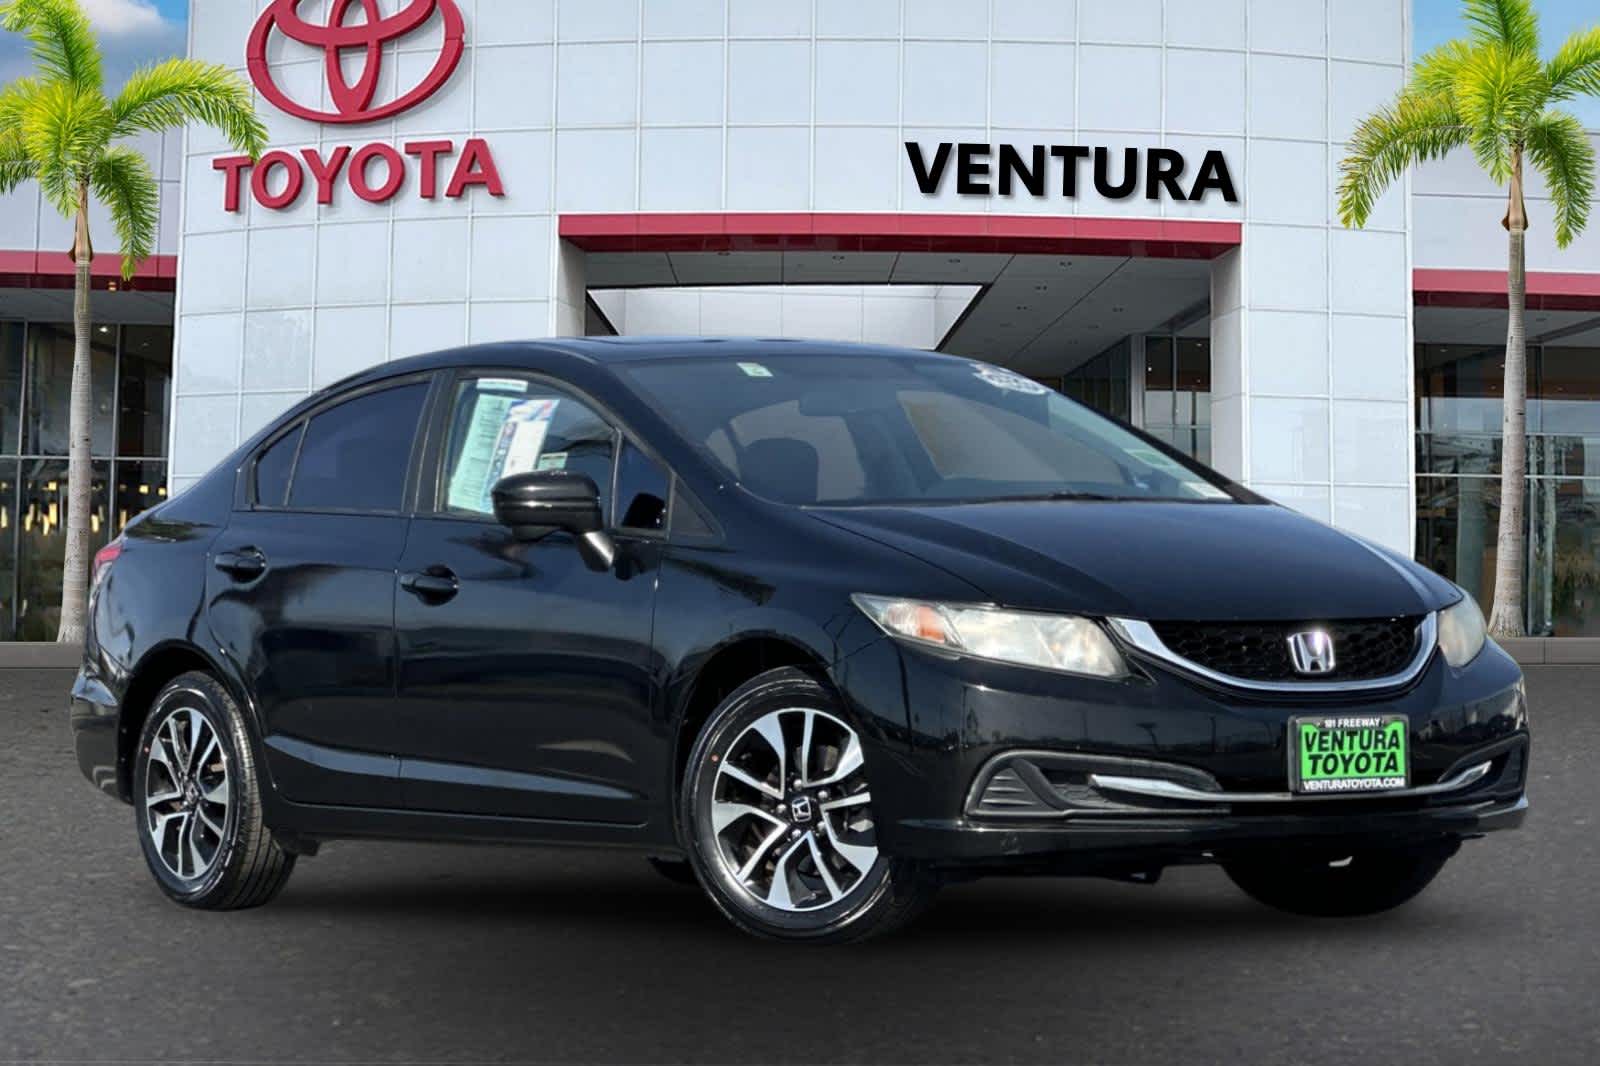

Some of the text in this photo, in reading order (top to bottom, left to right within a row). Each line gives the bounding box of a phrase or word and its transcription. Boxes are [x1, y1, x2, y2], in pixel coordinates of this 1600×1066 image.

[212, 138, 505, 213] TOYOTA
[904, 141, 1239, 203] VENTURA
[1337, 718, 1381, 728] FREEWAY
[1304, 729, 1400, 752] VENTURA
[1308, 751, 1399, 775] TOYOTA
[1303, 777, 1406, 791] VENTURATOYOTA.COM
